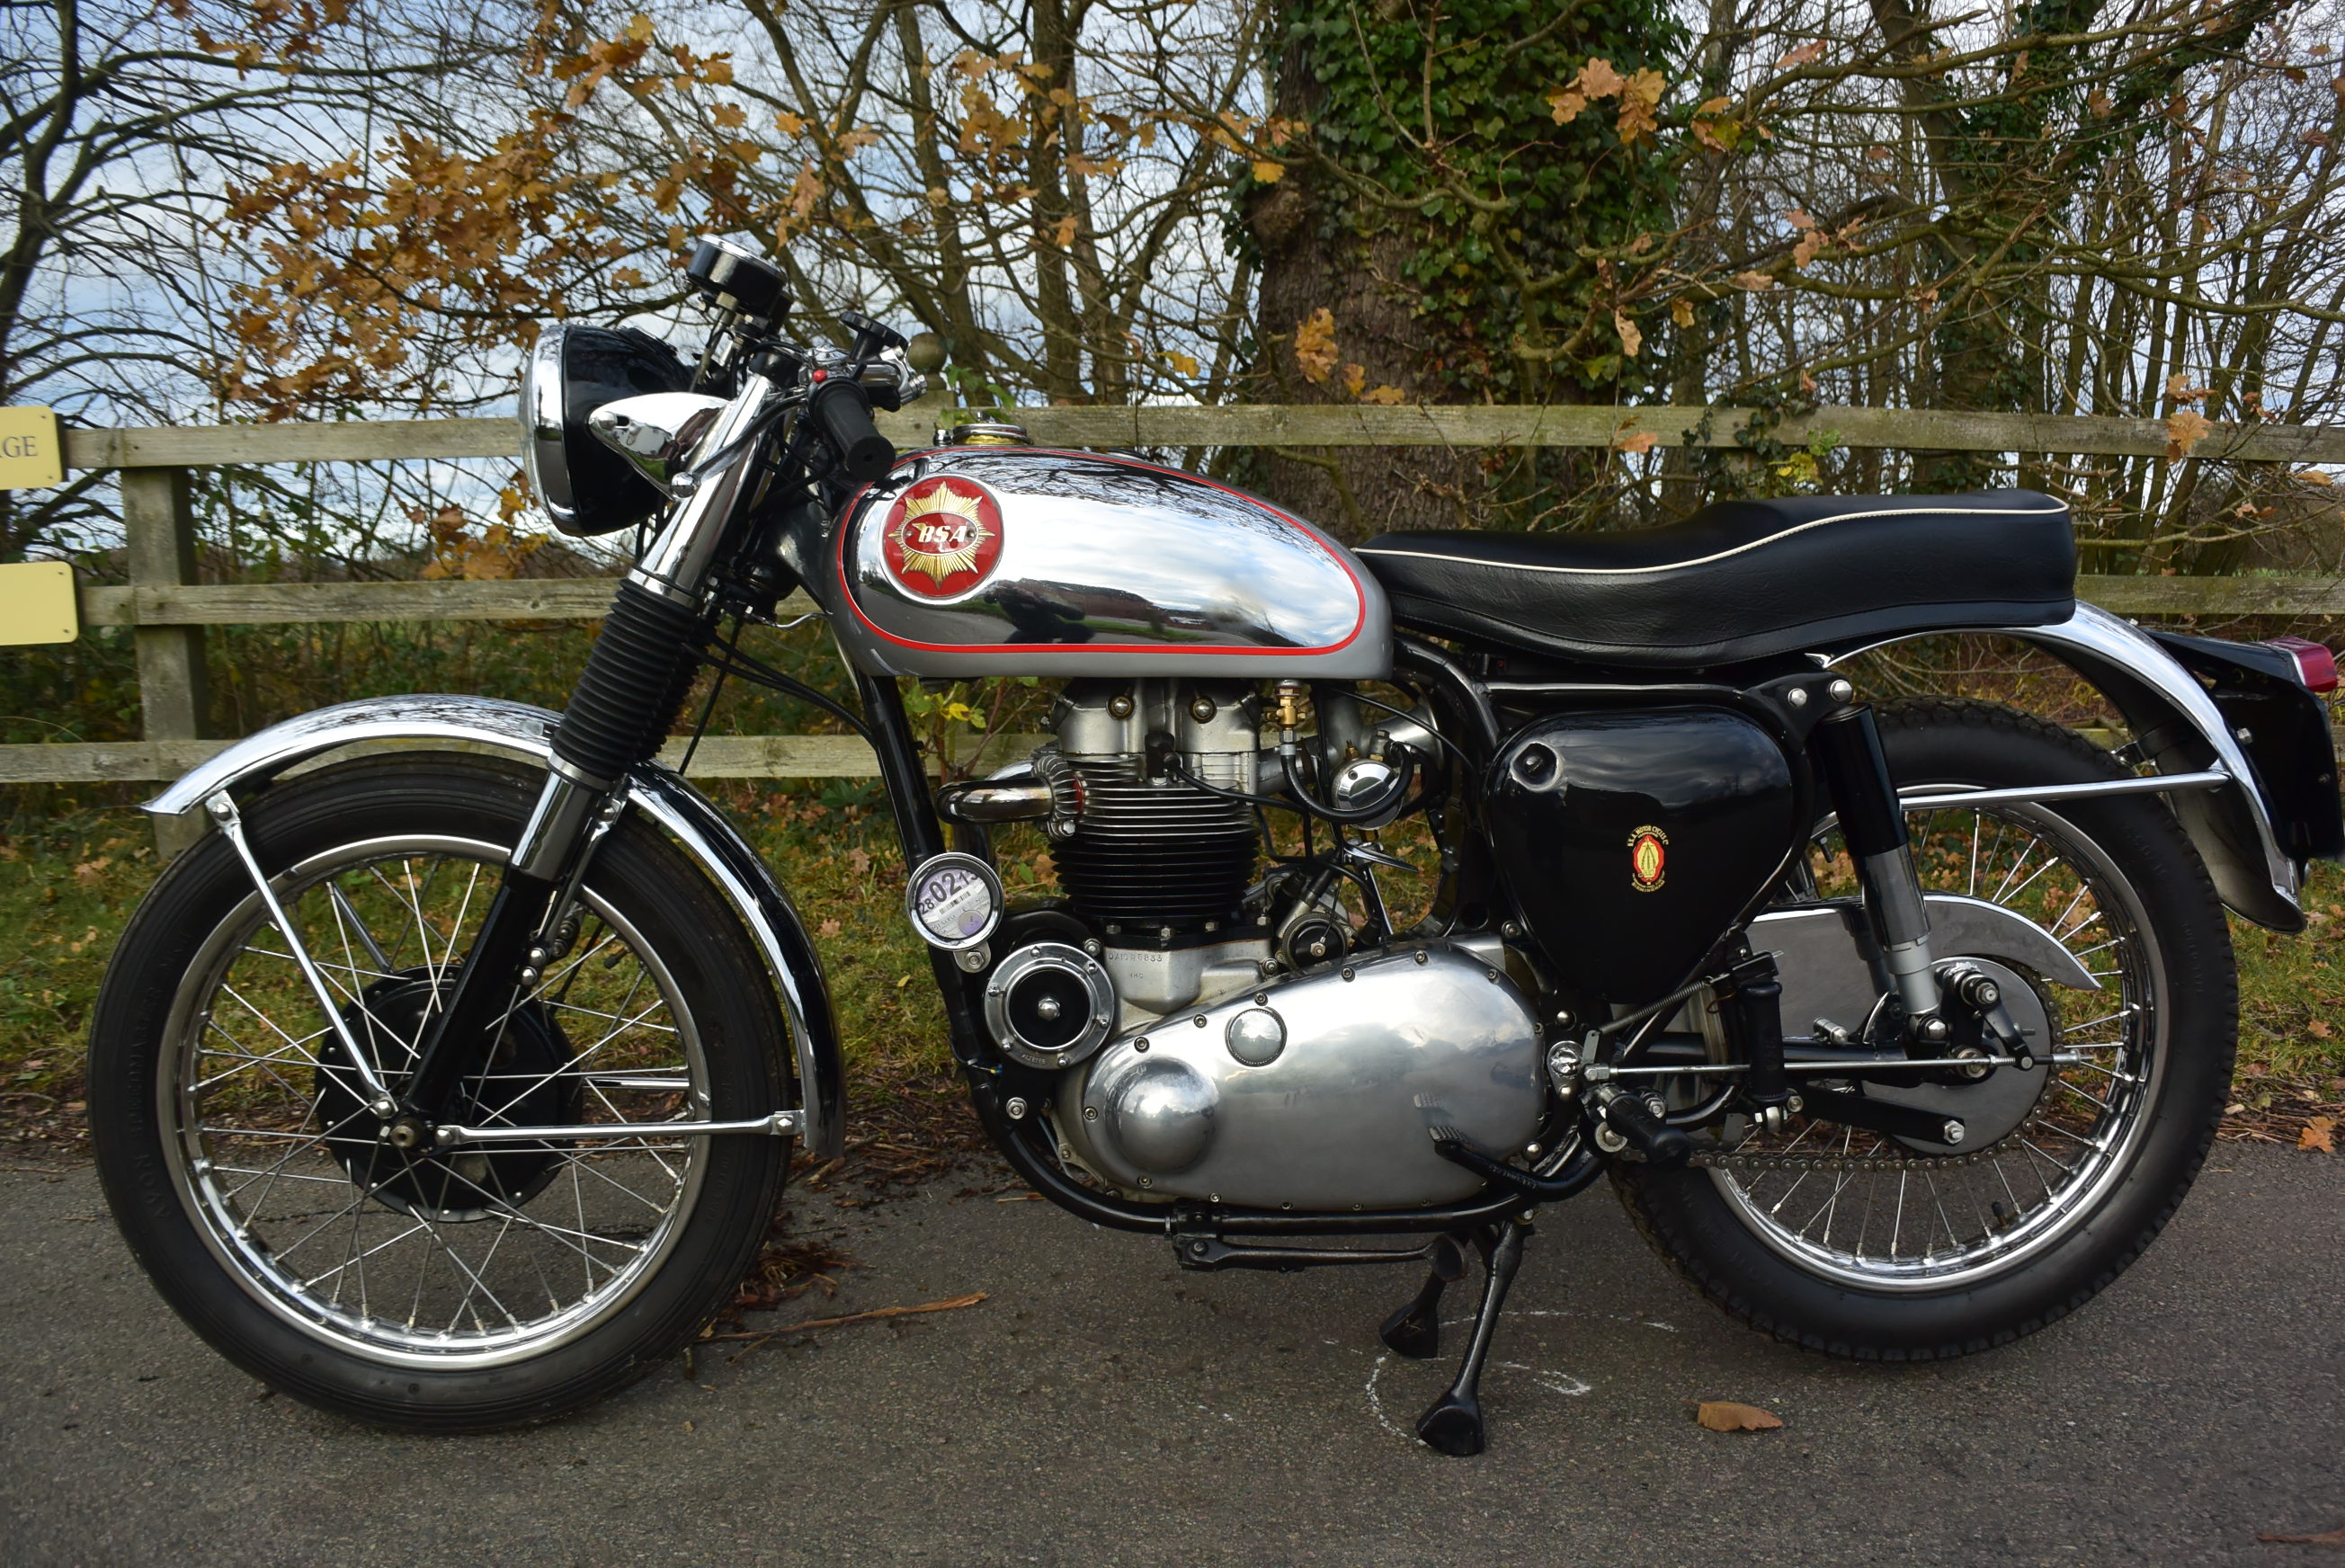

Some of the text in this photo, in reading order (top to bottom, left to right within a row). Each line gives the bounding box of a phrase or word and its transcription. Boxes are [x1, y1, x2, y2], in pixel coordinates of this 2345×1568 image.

[0, 436, 38, 458] GE
[915, 524, 967, 542] BSA
[918, 898, 934, 914] 28
[929, 873, 961, 902] 02
[133, 1154, 172, 1219] AVON
